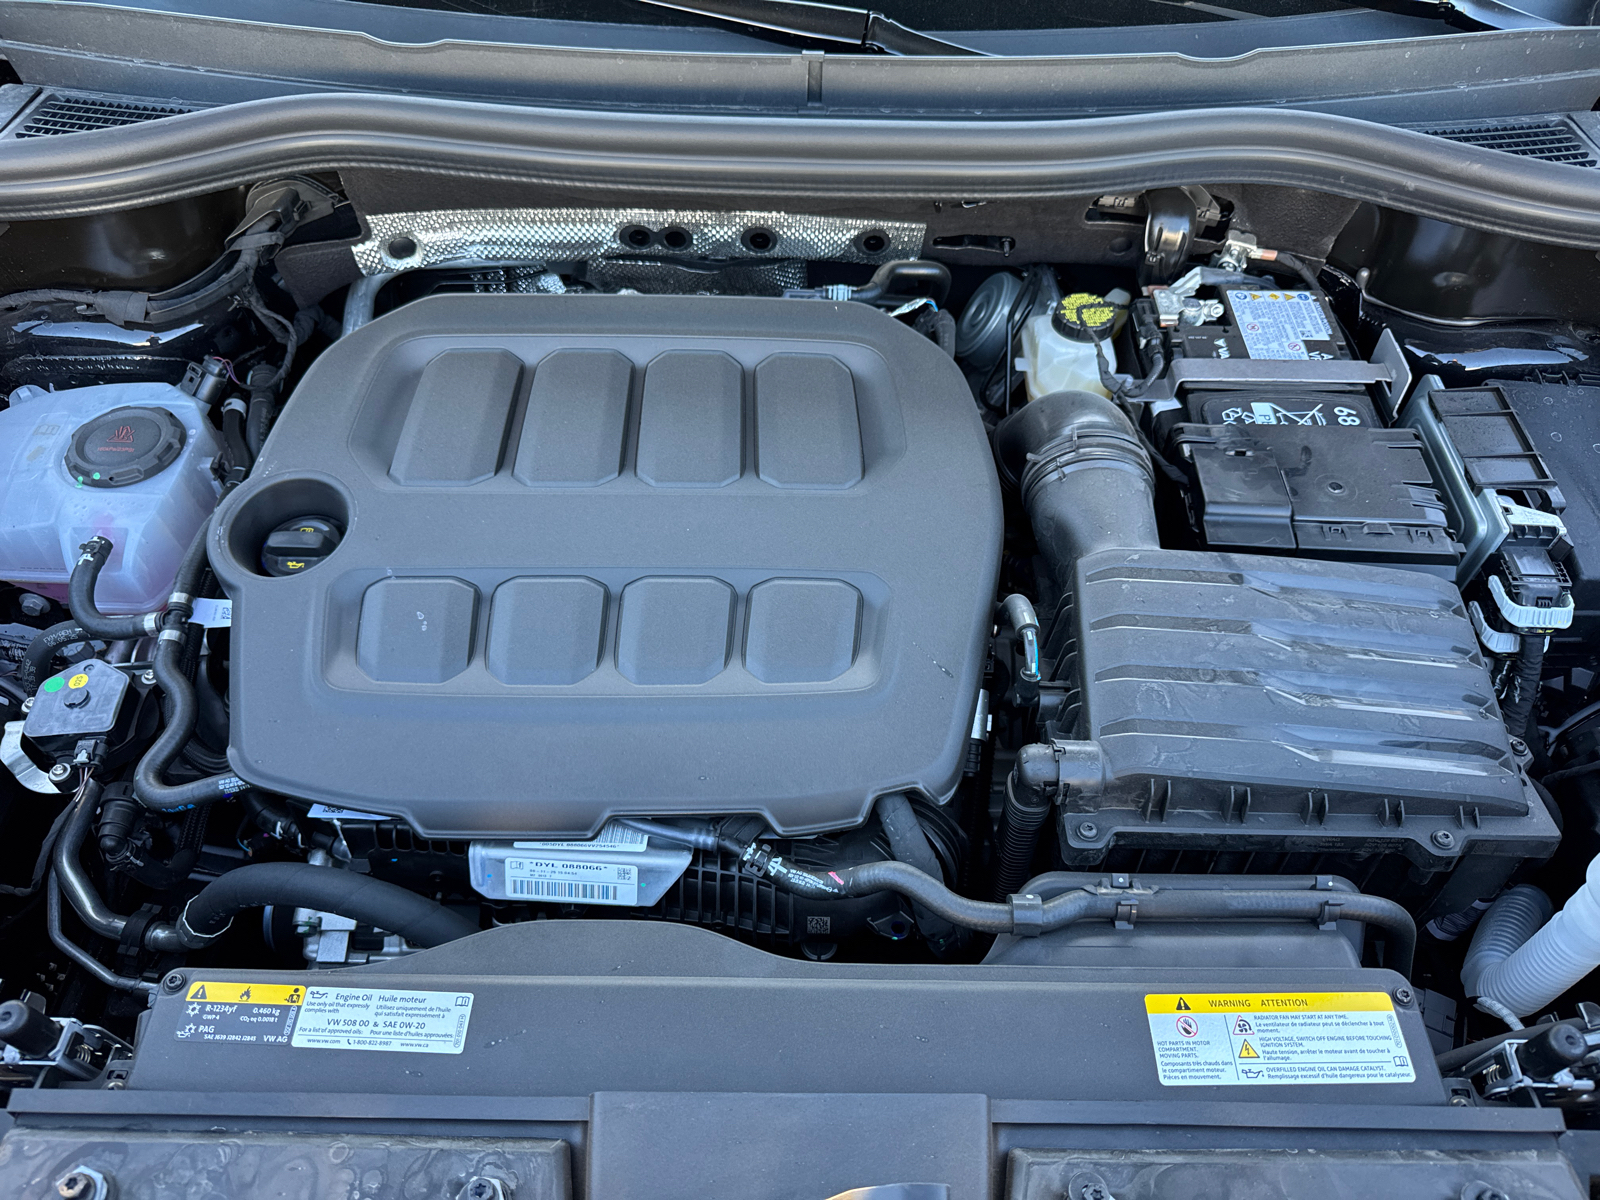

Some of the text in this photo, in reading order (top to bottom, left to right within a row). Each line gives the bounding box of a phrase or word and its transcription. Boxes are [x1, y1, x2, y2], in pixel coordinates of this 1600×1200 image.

[1334, 406, 1360, 426] 68
[335, 993, 360, 1002] Engine
[205, 1005, 238, 1014] R-1234yf
[400, 1021, 426, 1029] 0W-20
